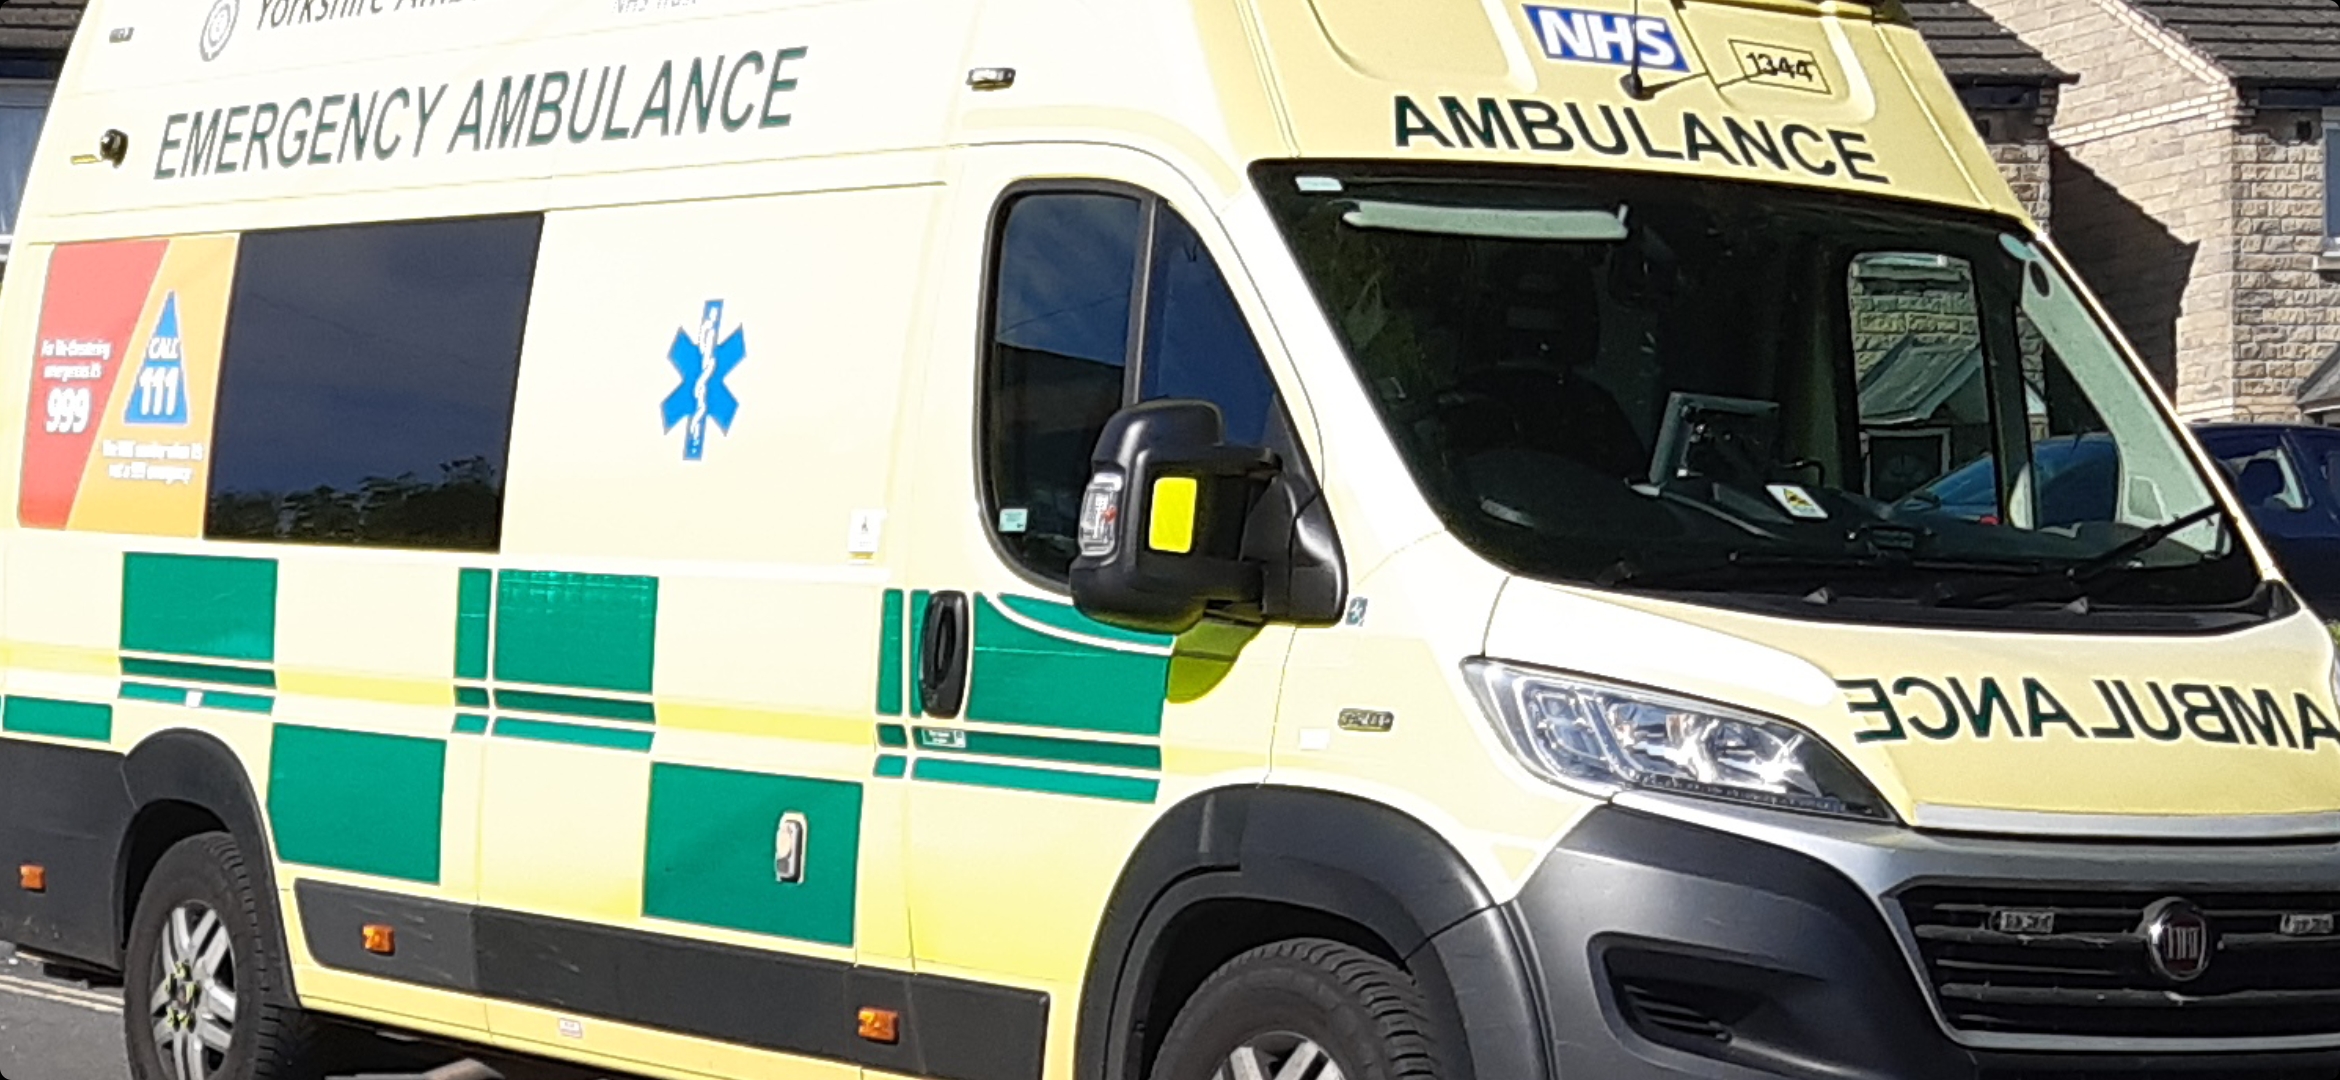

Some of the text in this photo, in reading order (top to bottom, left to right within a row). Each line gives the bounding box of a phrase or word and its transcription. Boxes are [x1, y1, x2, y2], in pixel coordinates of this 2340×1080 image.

[1543, 10, 1677, 67] NHS
[1746, 52, 1814, 82] 1344
[153, 46, 809, 180] EMERGENCY AMBULANCE
[1394, 95, 1890, 184] AMBULANCE
[149, 337, 179, 359] CALL
[46, 387, 90, 433] 999
[139, 366, 179, 415] 111
